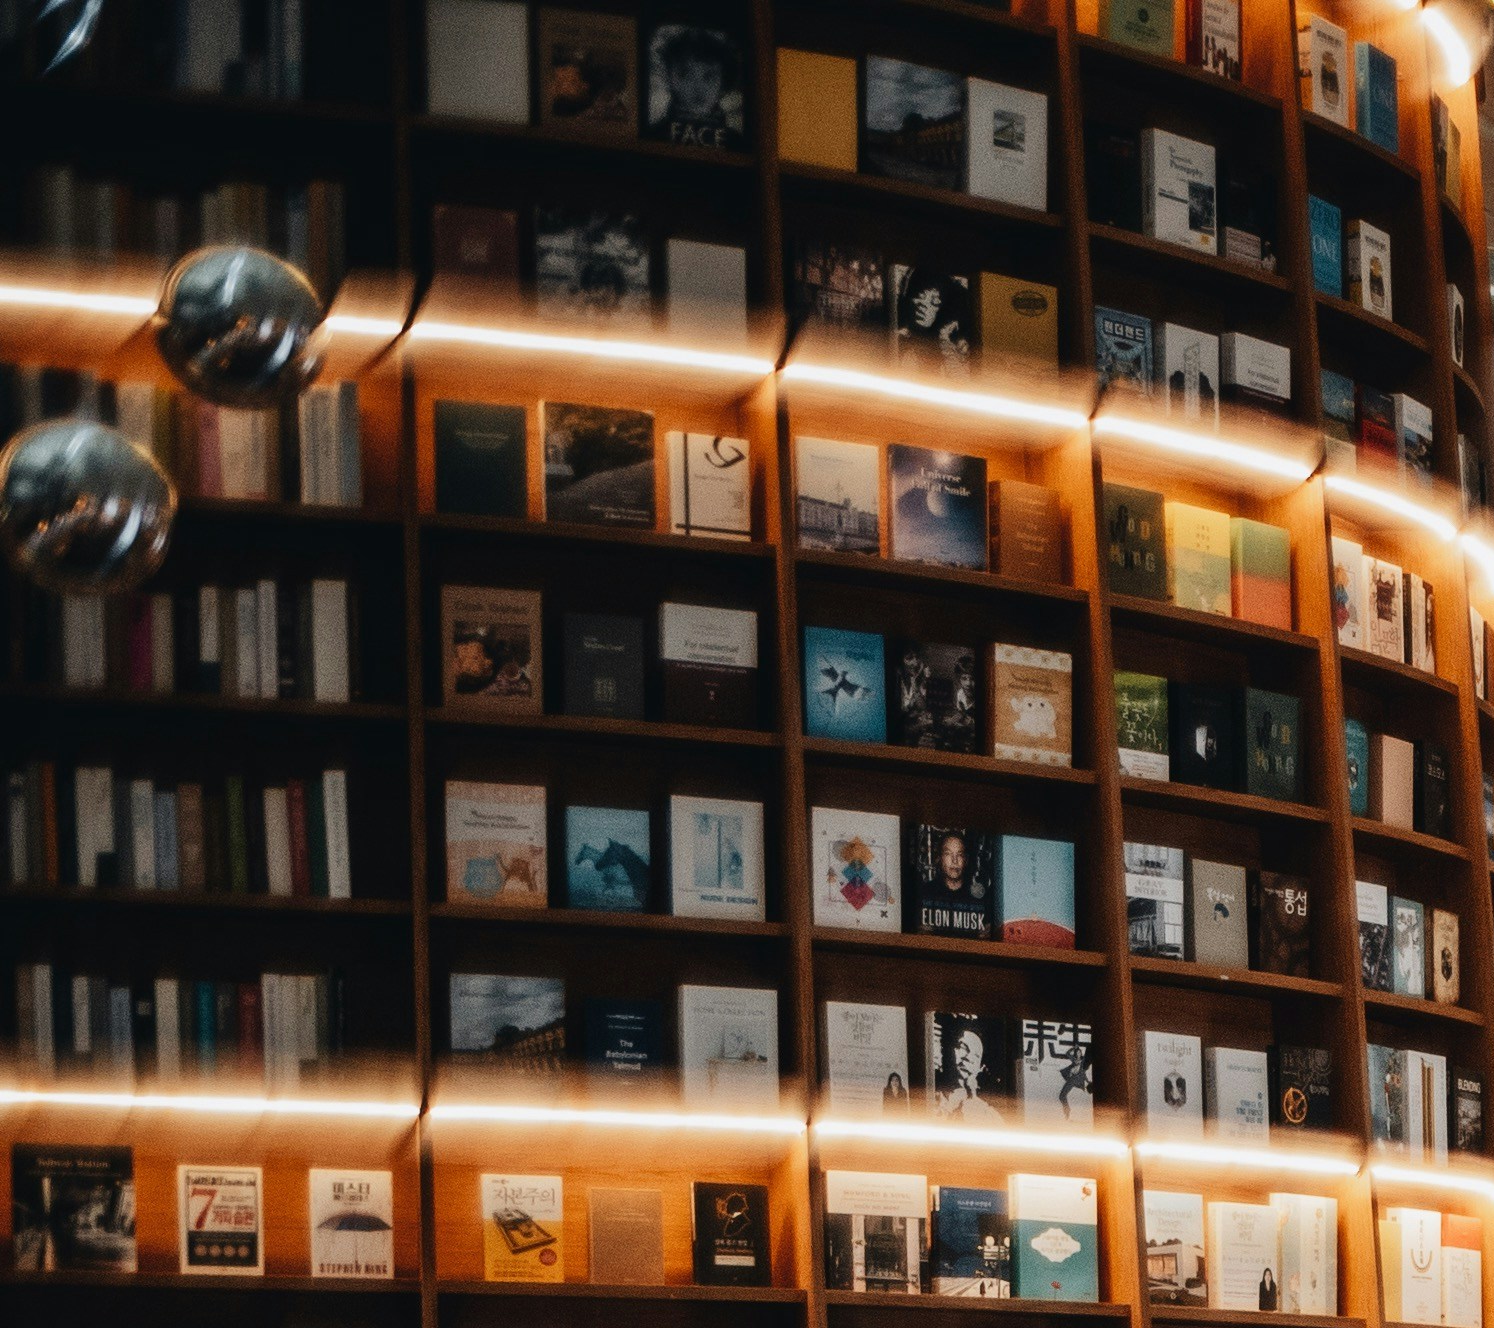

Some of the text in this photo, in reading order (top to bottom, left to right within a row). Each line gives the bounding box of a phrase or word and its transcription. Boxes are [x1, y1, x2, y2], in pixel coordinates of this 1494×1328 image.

[1284, 888, 1307, 917] 통섭
[922, 907, 986, 931] ELON MUSK
[190, 1188, 218, 1229] 7
[319, 1262, 362, 1275] STEPHEN
